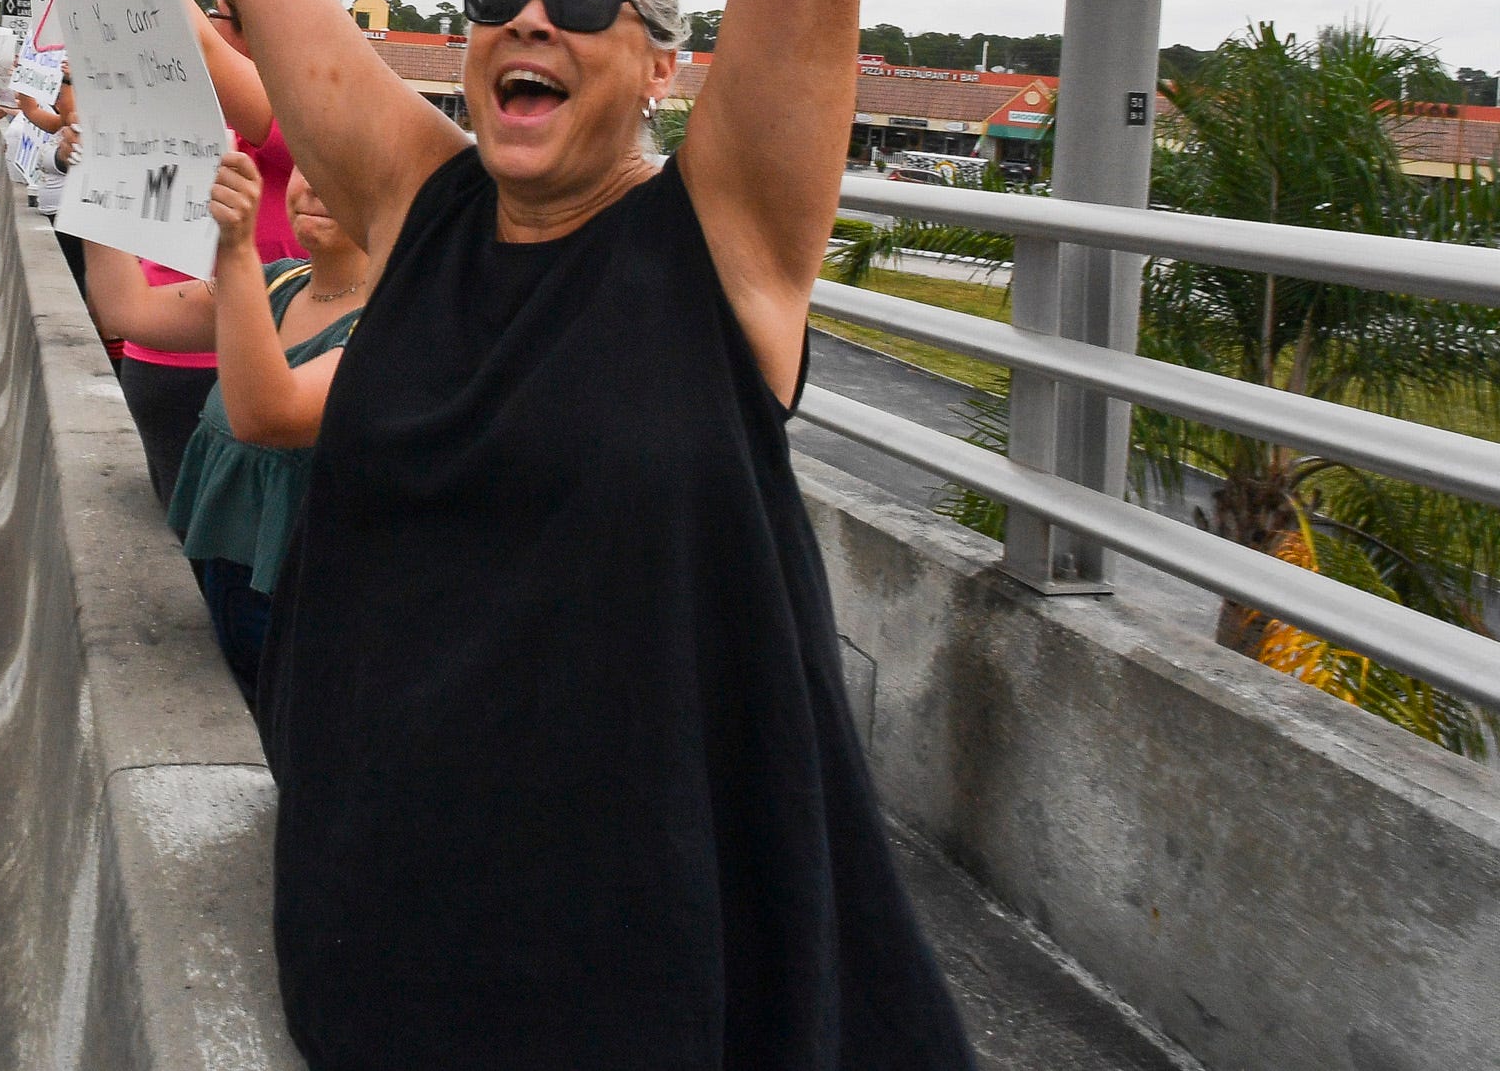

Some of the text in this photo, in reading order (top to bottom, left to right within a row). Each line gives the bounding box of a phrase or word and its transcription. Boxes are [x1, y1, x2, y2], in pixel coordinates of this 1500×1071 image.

[860, 65, 980, 83] PIZZA RESTAURANT BAR
